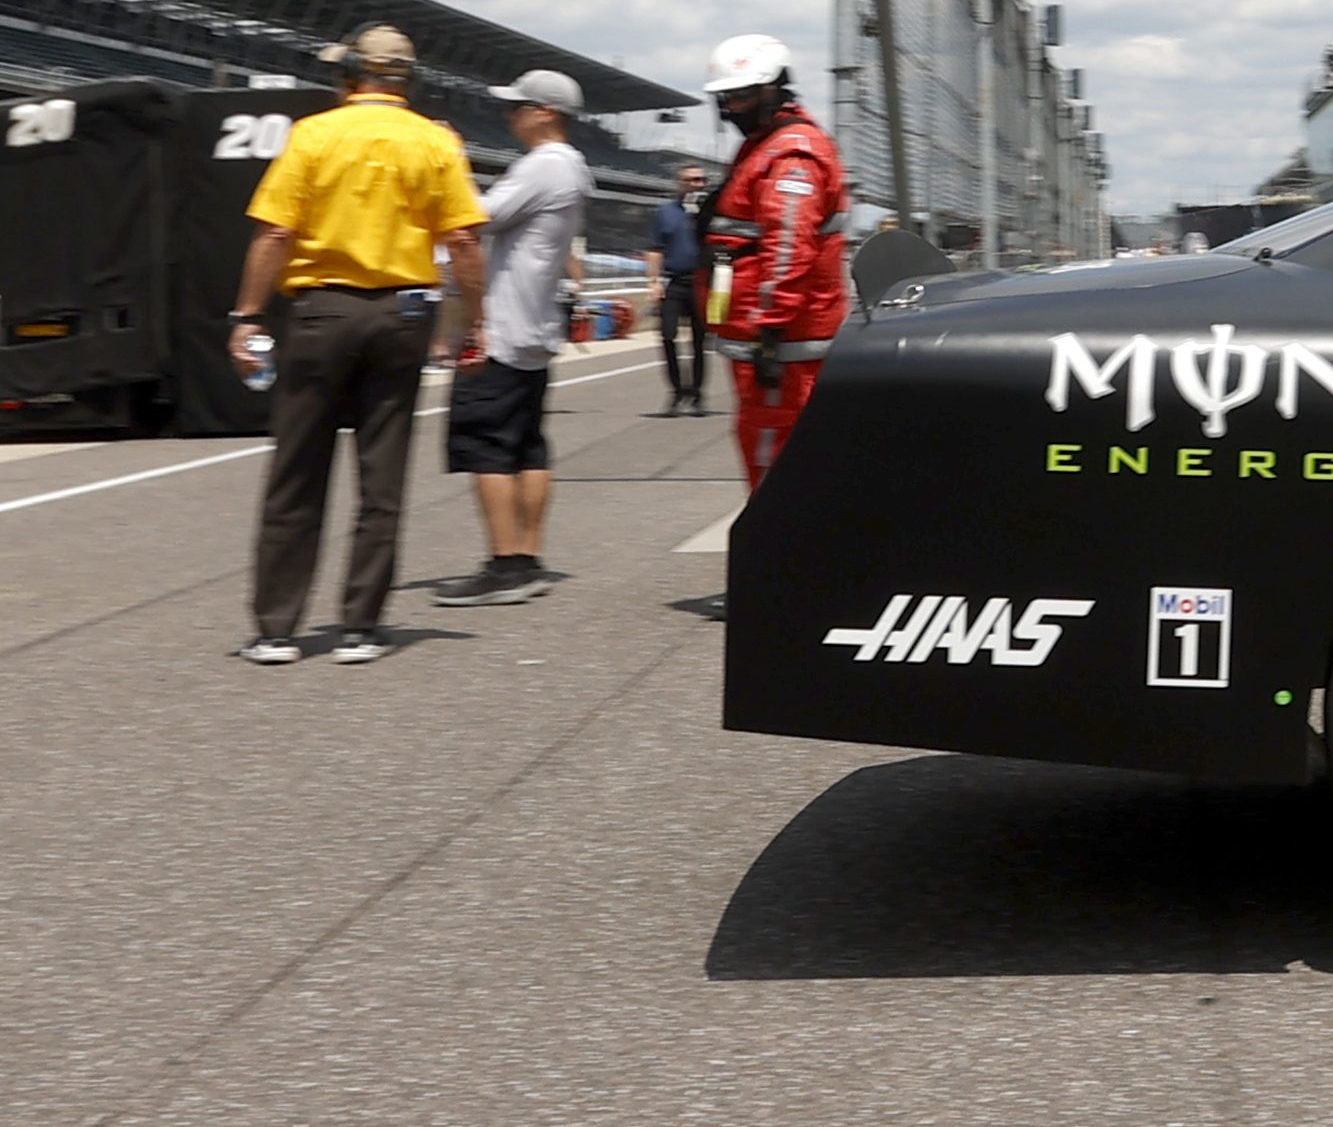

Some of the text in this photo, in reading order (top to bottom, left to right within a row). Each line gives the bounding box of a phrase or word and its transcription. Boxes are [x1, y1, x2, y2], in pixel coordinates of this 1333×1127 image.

[6, 99, 77, 148] 20
[212, 113, 293, 160] 20
[1156, 592, 1226, 616] Mobil
[820, 593, 1096, 666] HAAS
[1173, 622, 1200, 677] 1
